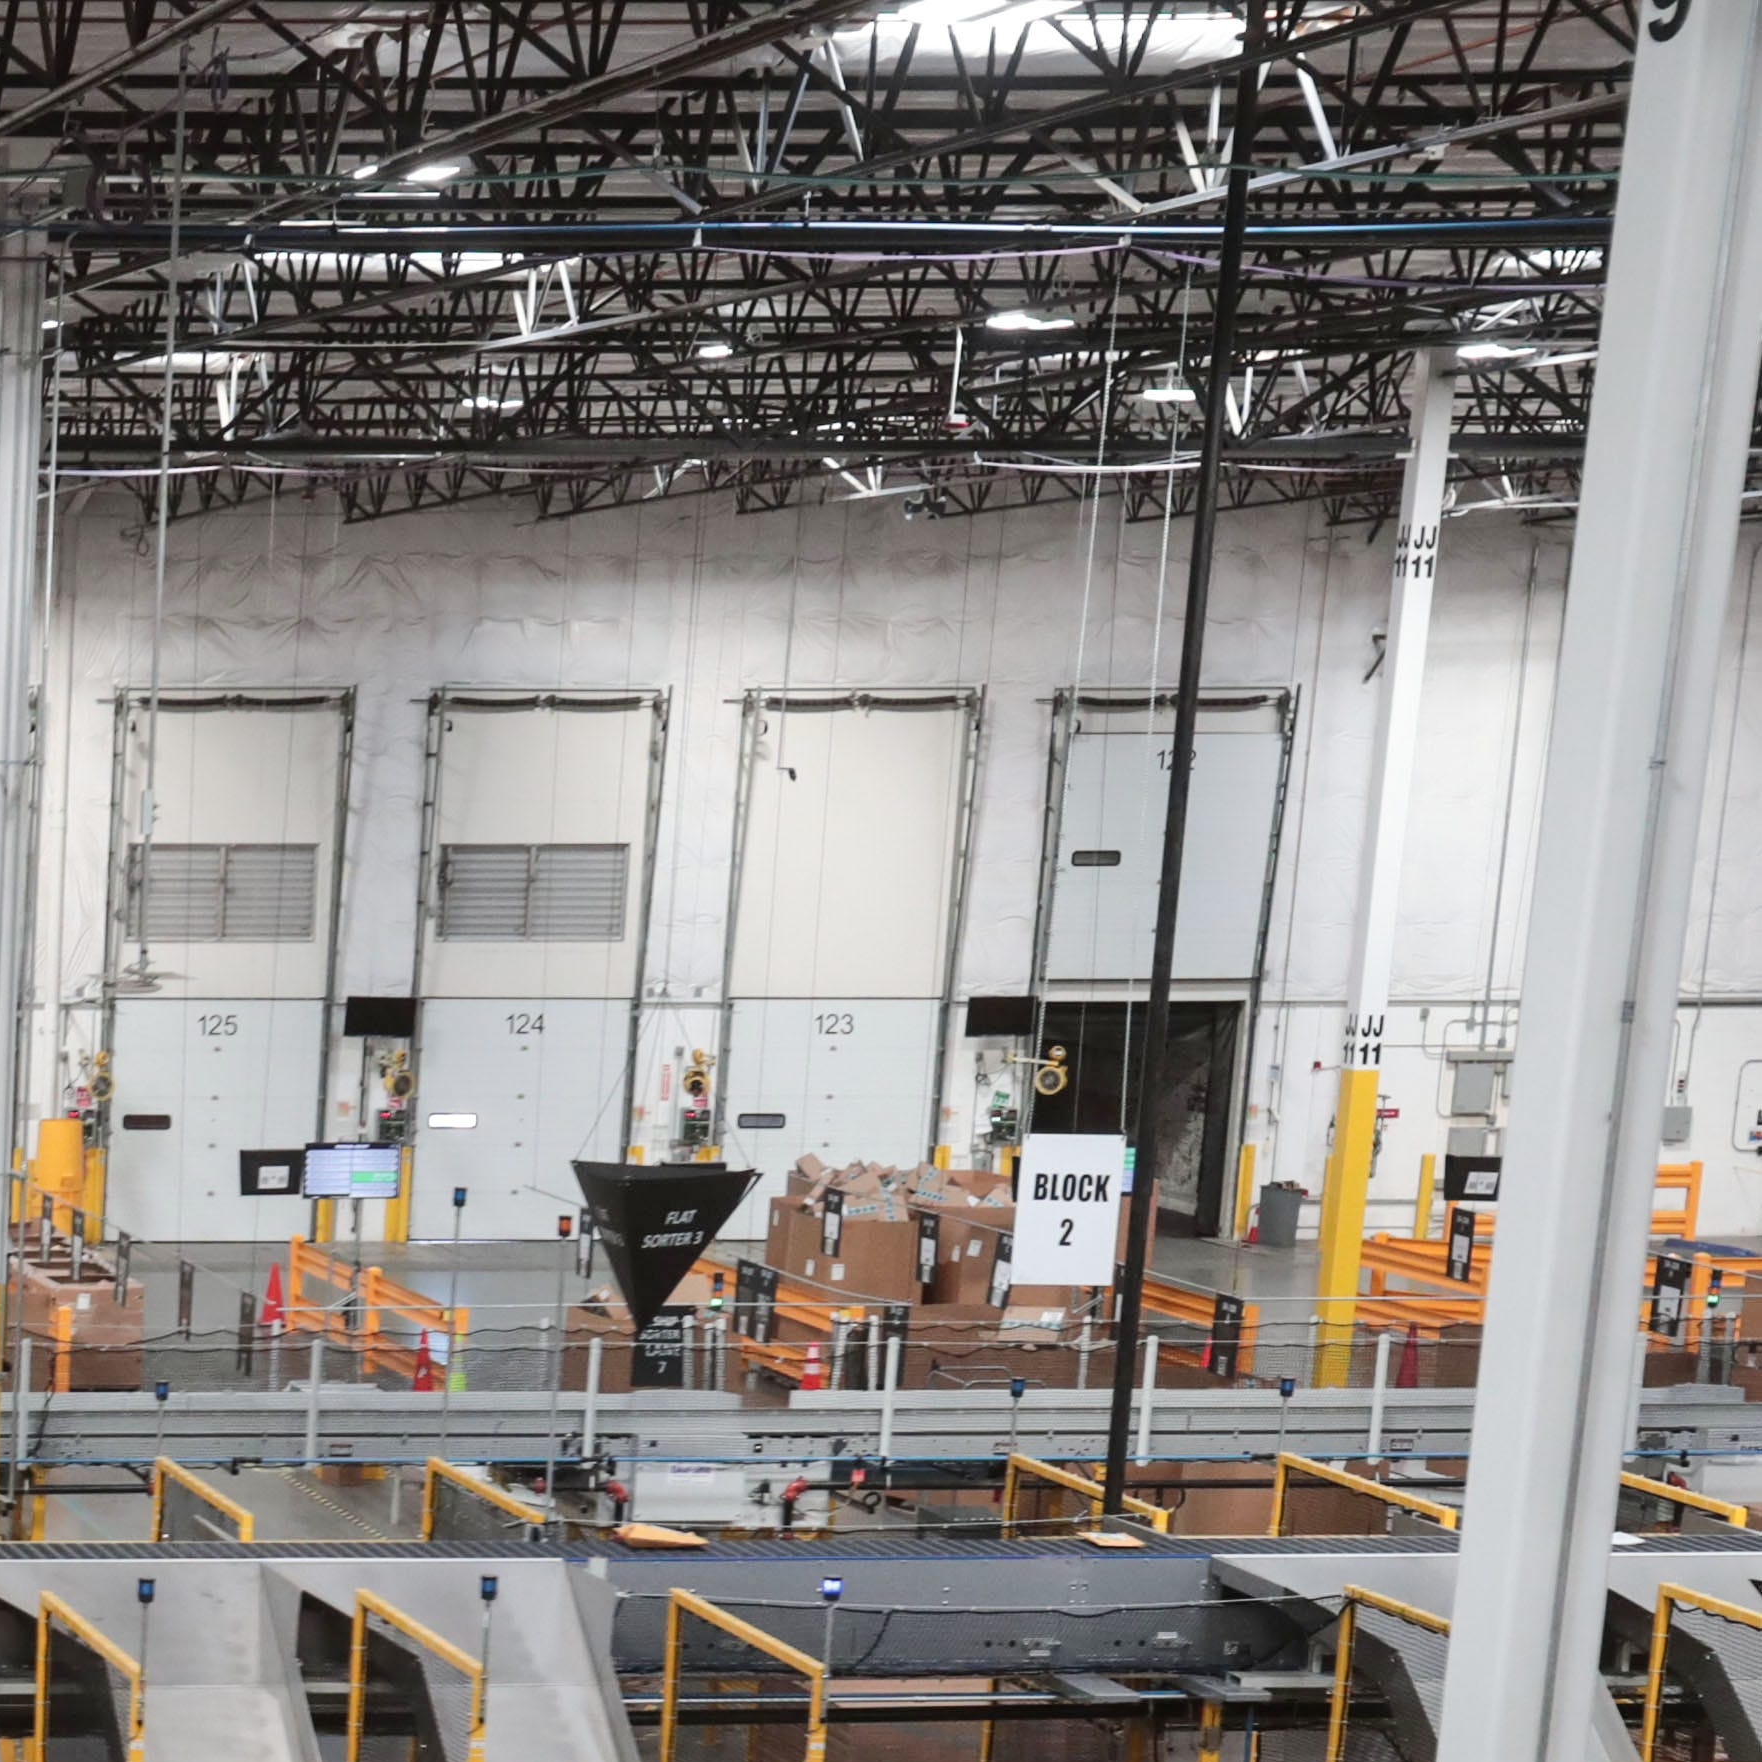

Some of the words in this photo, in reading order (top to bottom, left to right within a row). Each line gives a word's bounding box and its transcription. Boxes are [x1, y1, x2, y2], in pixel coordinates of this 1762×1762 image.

[1414, 526, 1437, 550] JJ
[1411, 555, 1435, 579] 11
[197, 1015, 238, 1037] 125
[505, 1014, 545, 1036] 124
[815, 1014, 854, 1035] 123
[1362, 1014, 1385, 1038] JJ
[1359, 1043, 1382, 1065] 11
[1033, 1174, 1110, 1202] BLOCK
[664, 1209, 697, 1225] FLAT
[641, 1231, 691, 1249] SORTER
[693, 1231, 704, 1244] 3
[1058, 1219, 1074, 1246] 2
[657, 1361, 667, 1373] 7
